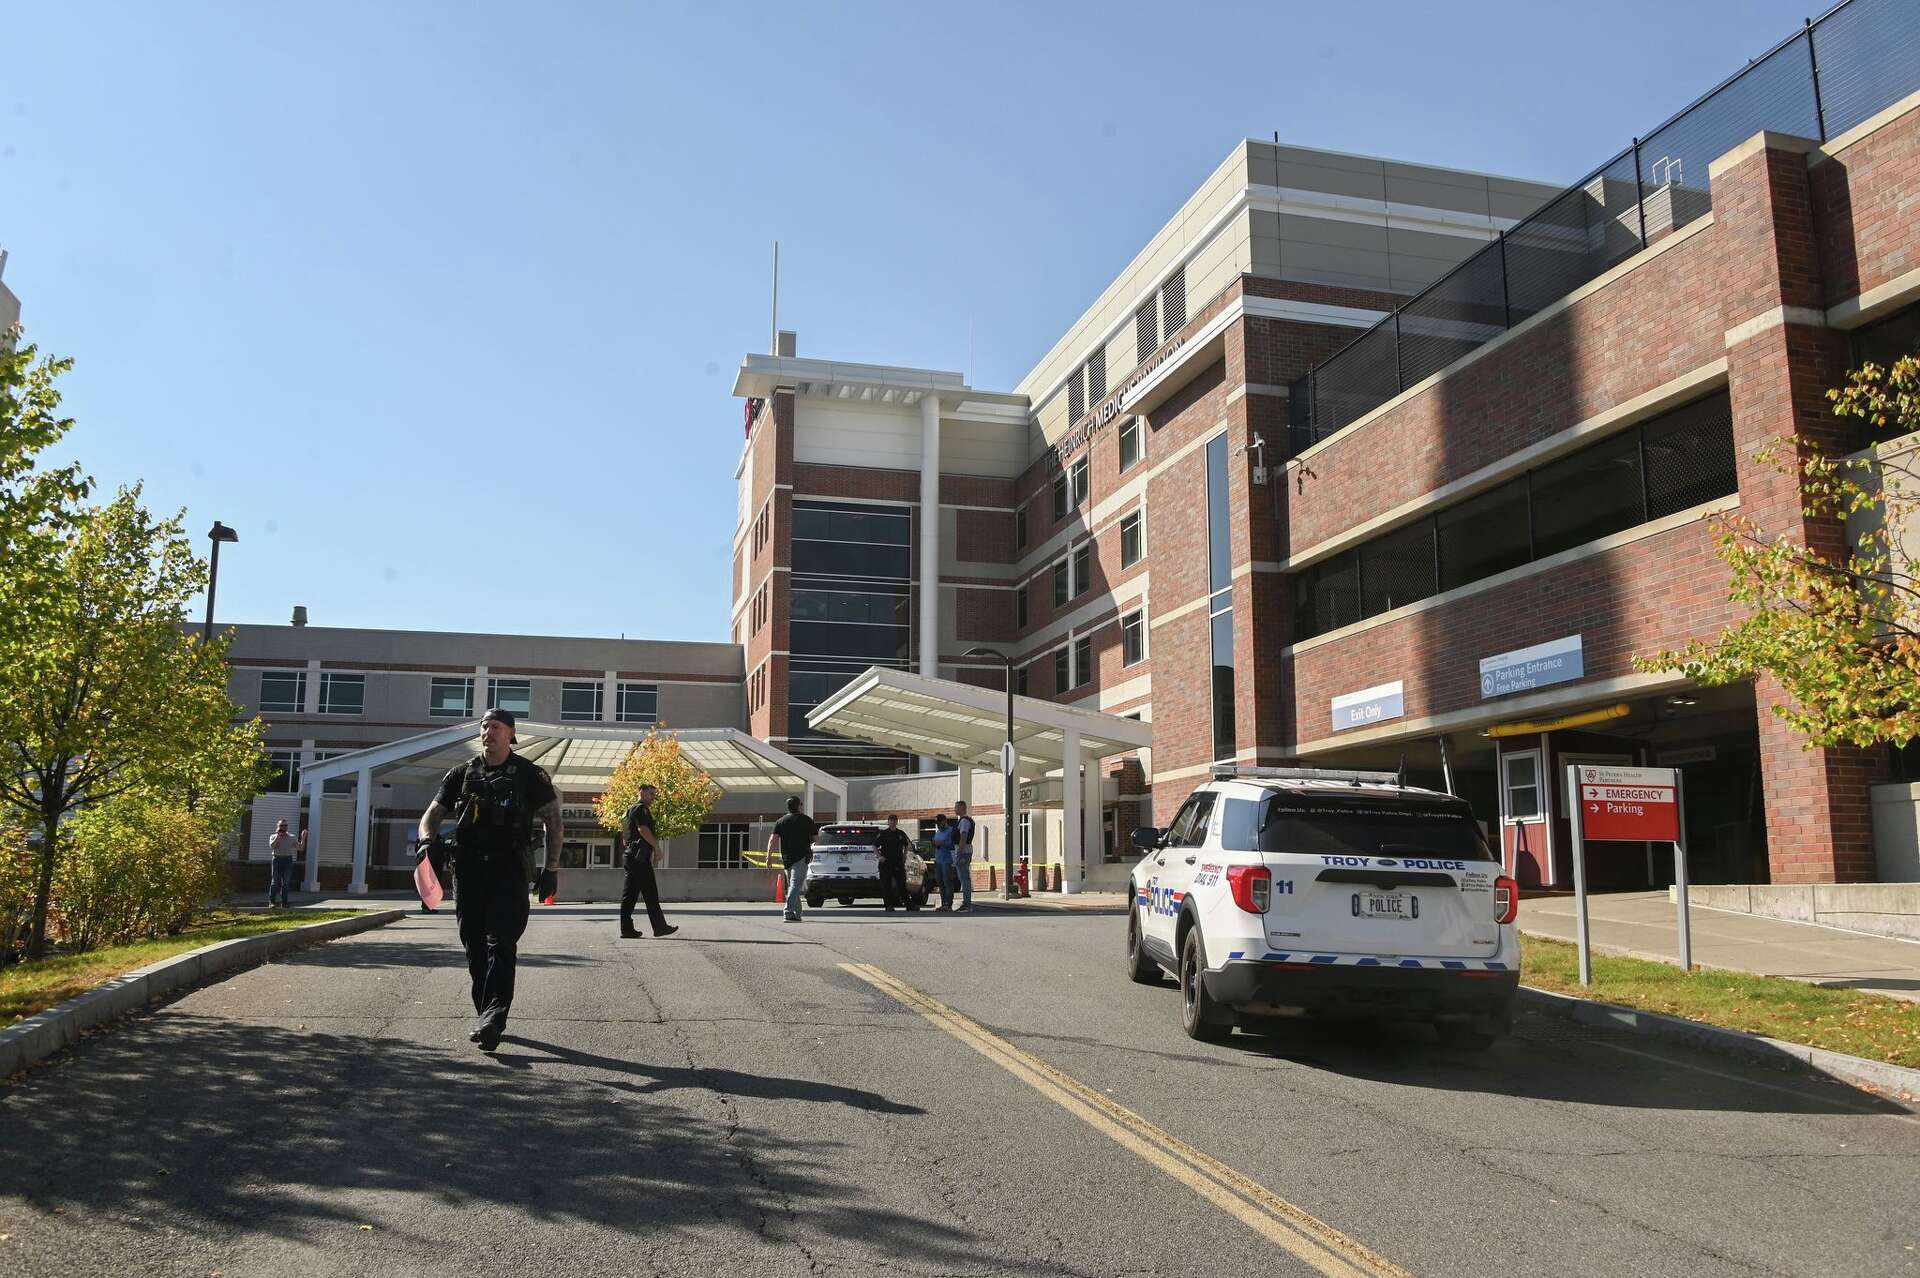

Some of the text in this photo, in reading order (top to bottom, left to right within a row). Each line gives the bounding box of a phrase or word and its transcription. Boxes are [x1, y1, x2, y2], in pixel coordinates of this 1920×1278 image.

[1058, 415, 1097, 461] HEINRICH
[1495, 666, 1526, 680] Parking
[1526, 657, 1562, 674] Entrance
[1496, 678, 1536, 694] Free Parking
[1351, 703, 1382, 721] Exit Only
[1606, 789, 1663, 800] EMERGENCY
[1607, 802, 1644, 816] Parking
[1320, 855, 1370, 867] TROY
[1403, 859, 1466, 870] POLICE
[1194, 873, 1219, 887] DIAL 911
[1276, 879, 1294, 894] 11
[1151, 886, 1175, 917] POLICE
[1369, 898, 1402, 913] POLICE
